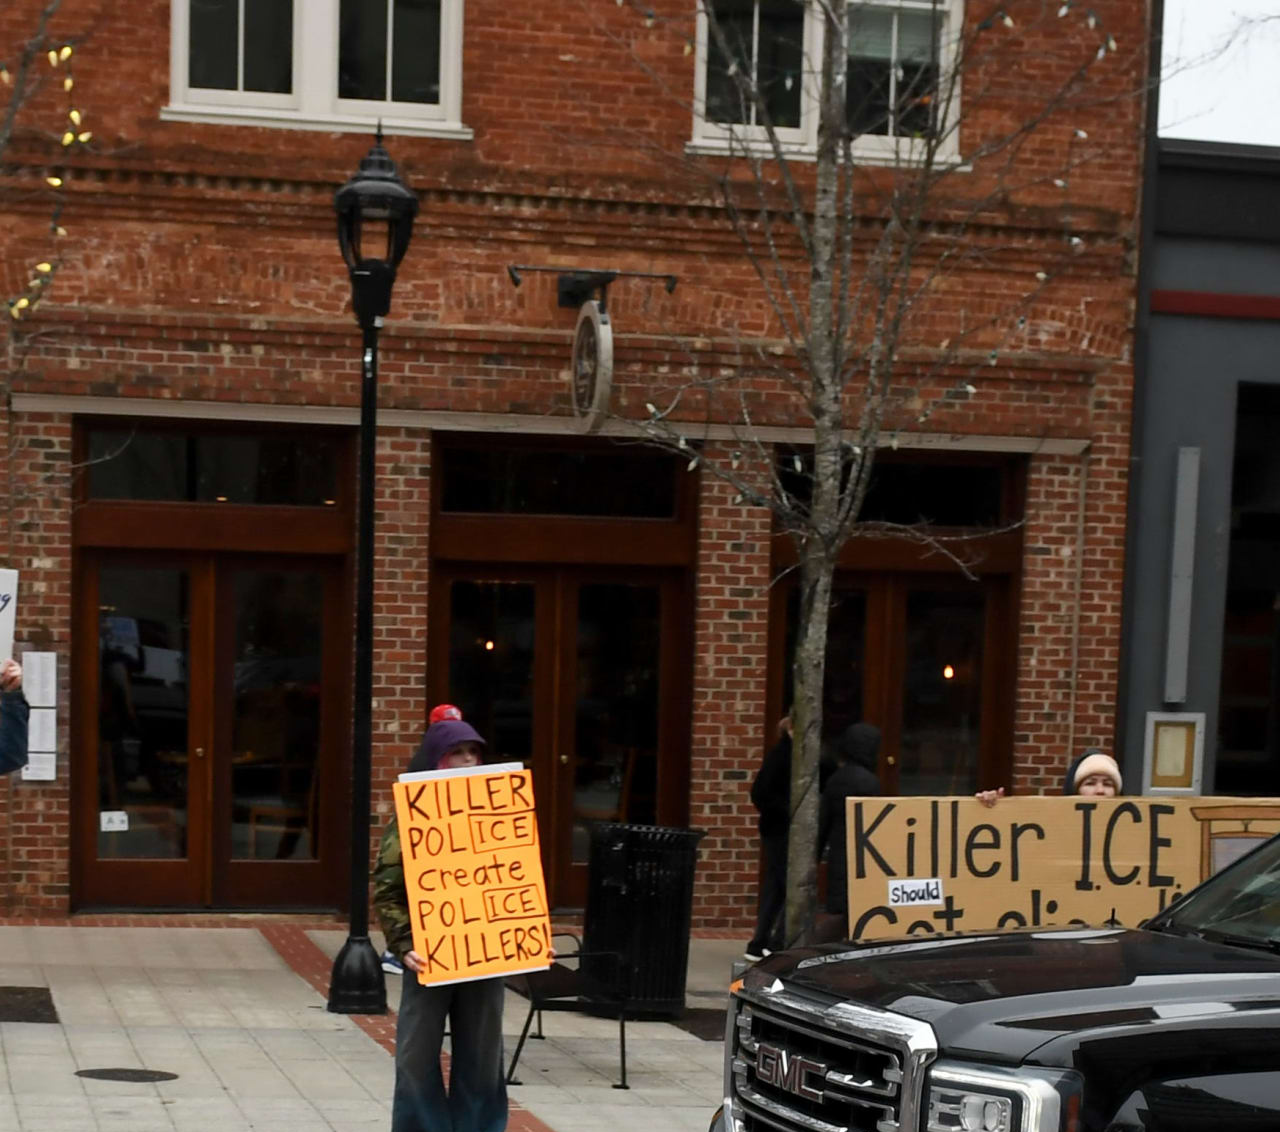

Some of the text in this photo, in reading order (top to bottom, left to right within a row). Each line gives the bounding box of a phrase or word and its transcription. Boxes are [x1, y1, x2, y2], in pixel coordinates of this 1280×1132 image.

[405, 775, 531, 821] KILLER
[854, 800, 1045, 882] Killer
[417, 854, 526, 892] create
[425, 922, 552, 974] KILLERS!
[756, 1042, 826, 1104] GMC
